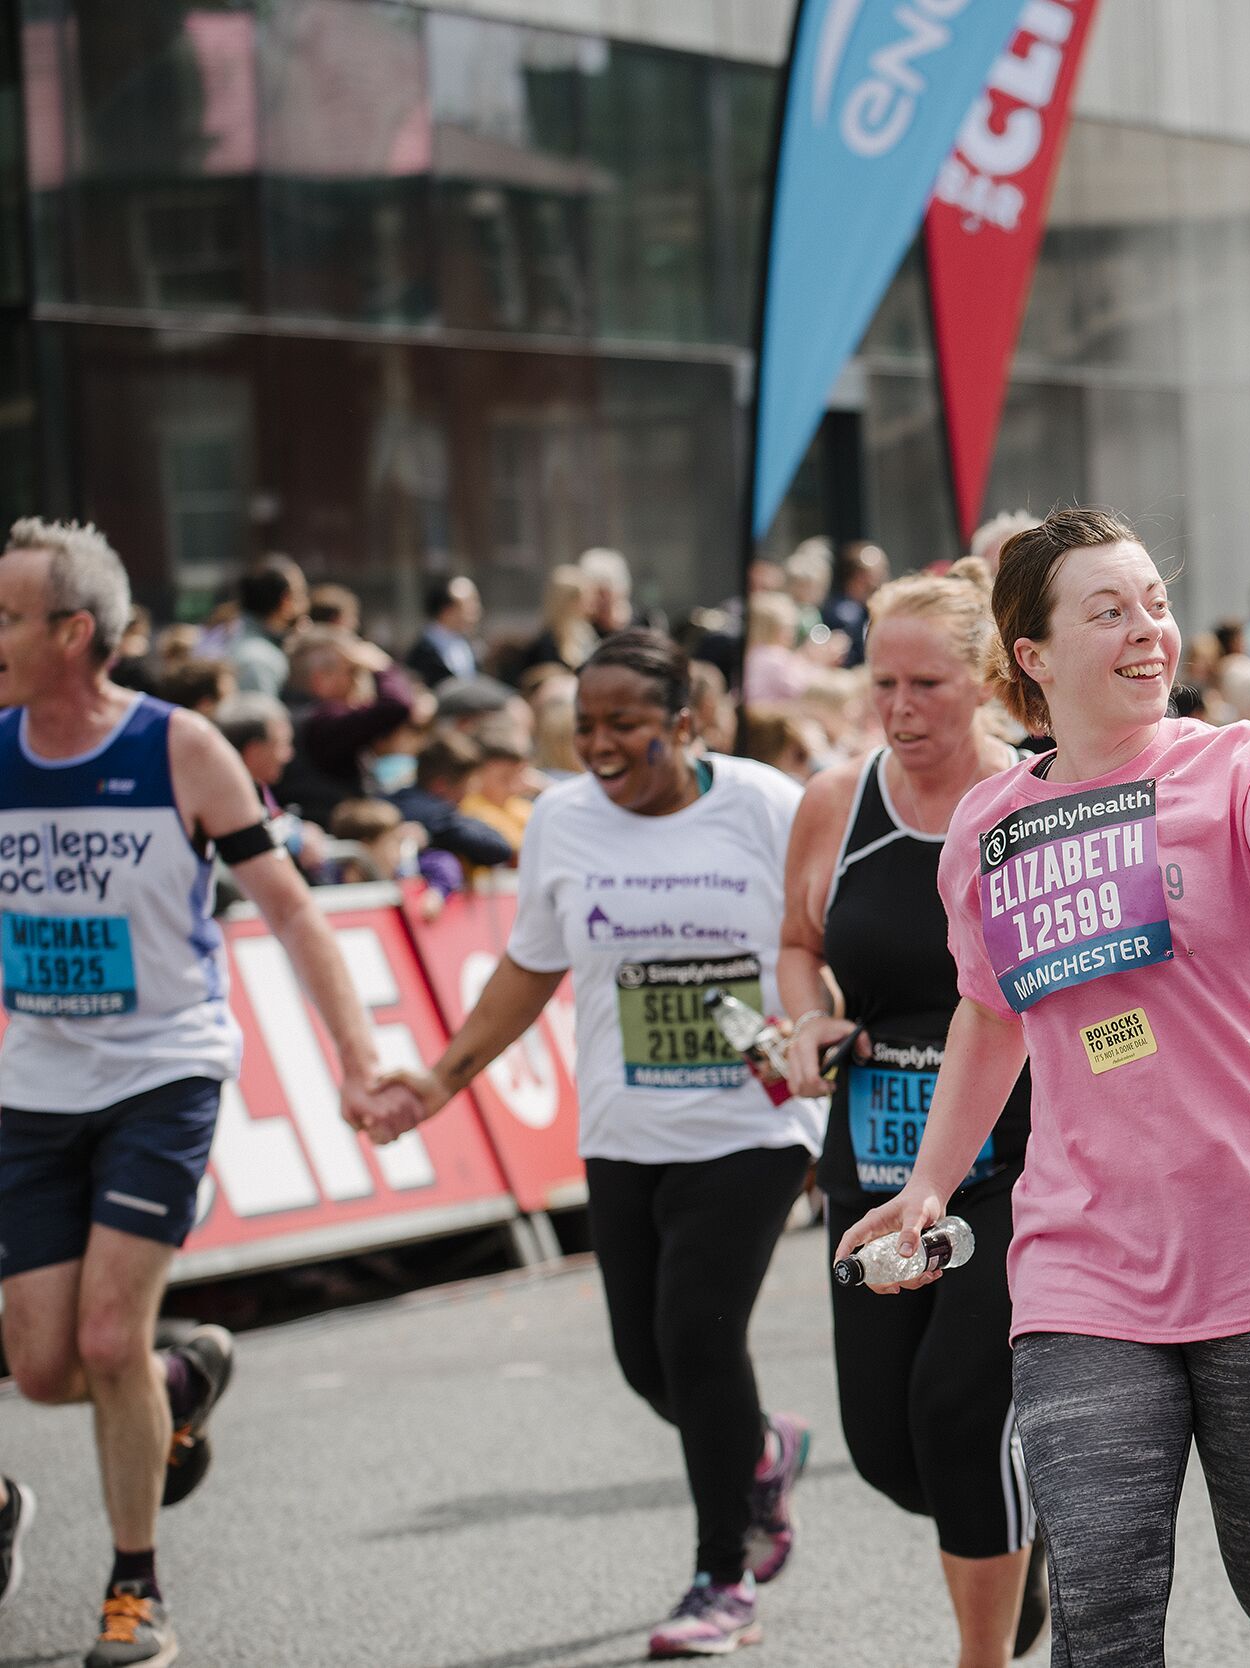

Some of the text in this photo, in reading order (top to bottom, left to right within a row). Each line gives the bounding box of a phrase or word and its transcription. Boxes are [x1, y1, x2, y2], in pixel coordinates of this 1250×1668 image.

[1009, 791, 1150, 844] Simplyhealth
[0, 864, 111, 902] ociety
[624, 870, 747, 894] supporting
[990, 823, 1143, 918] ELIZABETH
[11, 918, 117, 949] MICHAEL
[1012, 881, 1122, 960] 12599
[24, 955, 104, 987] 15925
[647, 959, 758, 985] Simplyhealth
[1013, 935, 1151, 1000] MANCHESTER
[15, 992, 124, 1011] MANCHESTER
[1086, 1013, 1140, 1042] BOLLOCKS
[1089, 1024, 1144, 1053] TO BREXIT
[871, 1074, 936, 1114] HELE
[868, 1119, 926, 1155] 158
